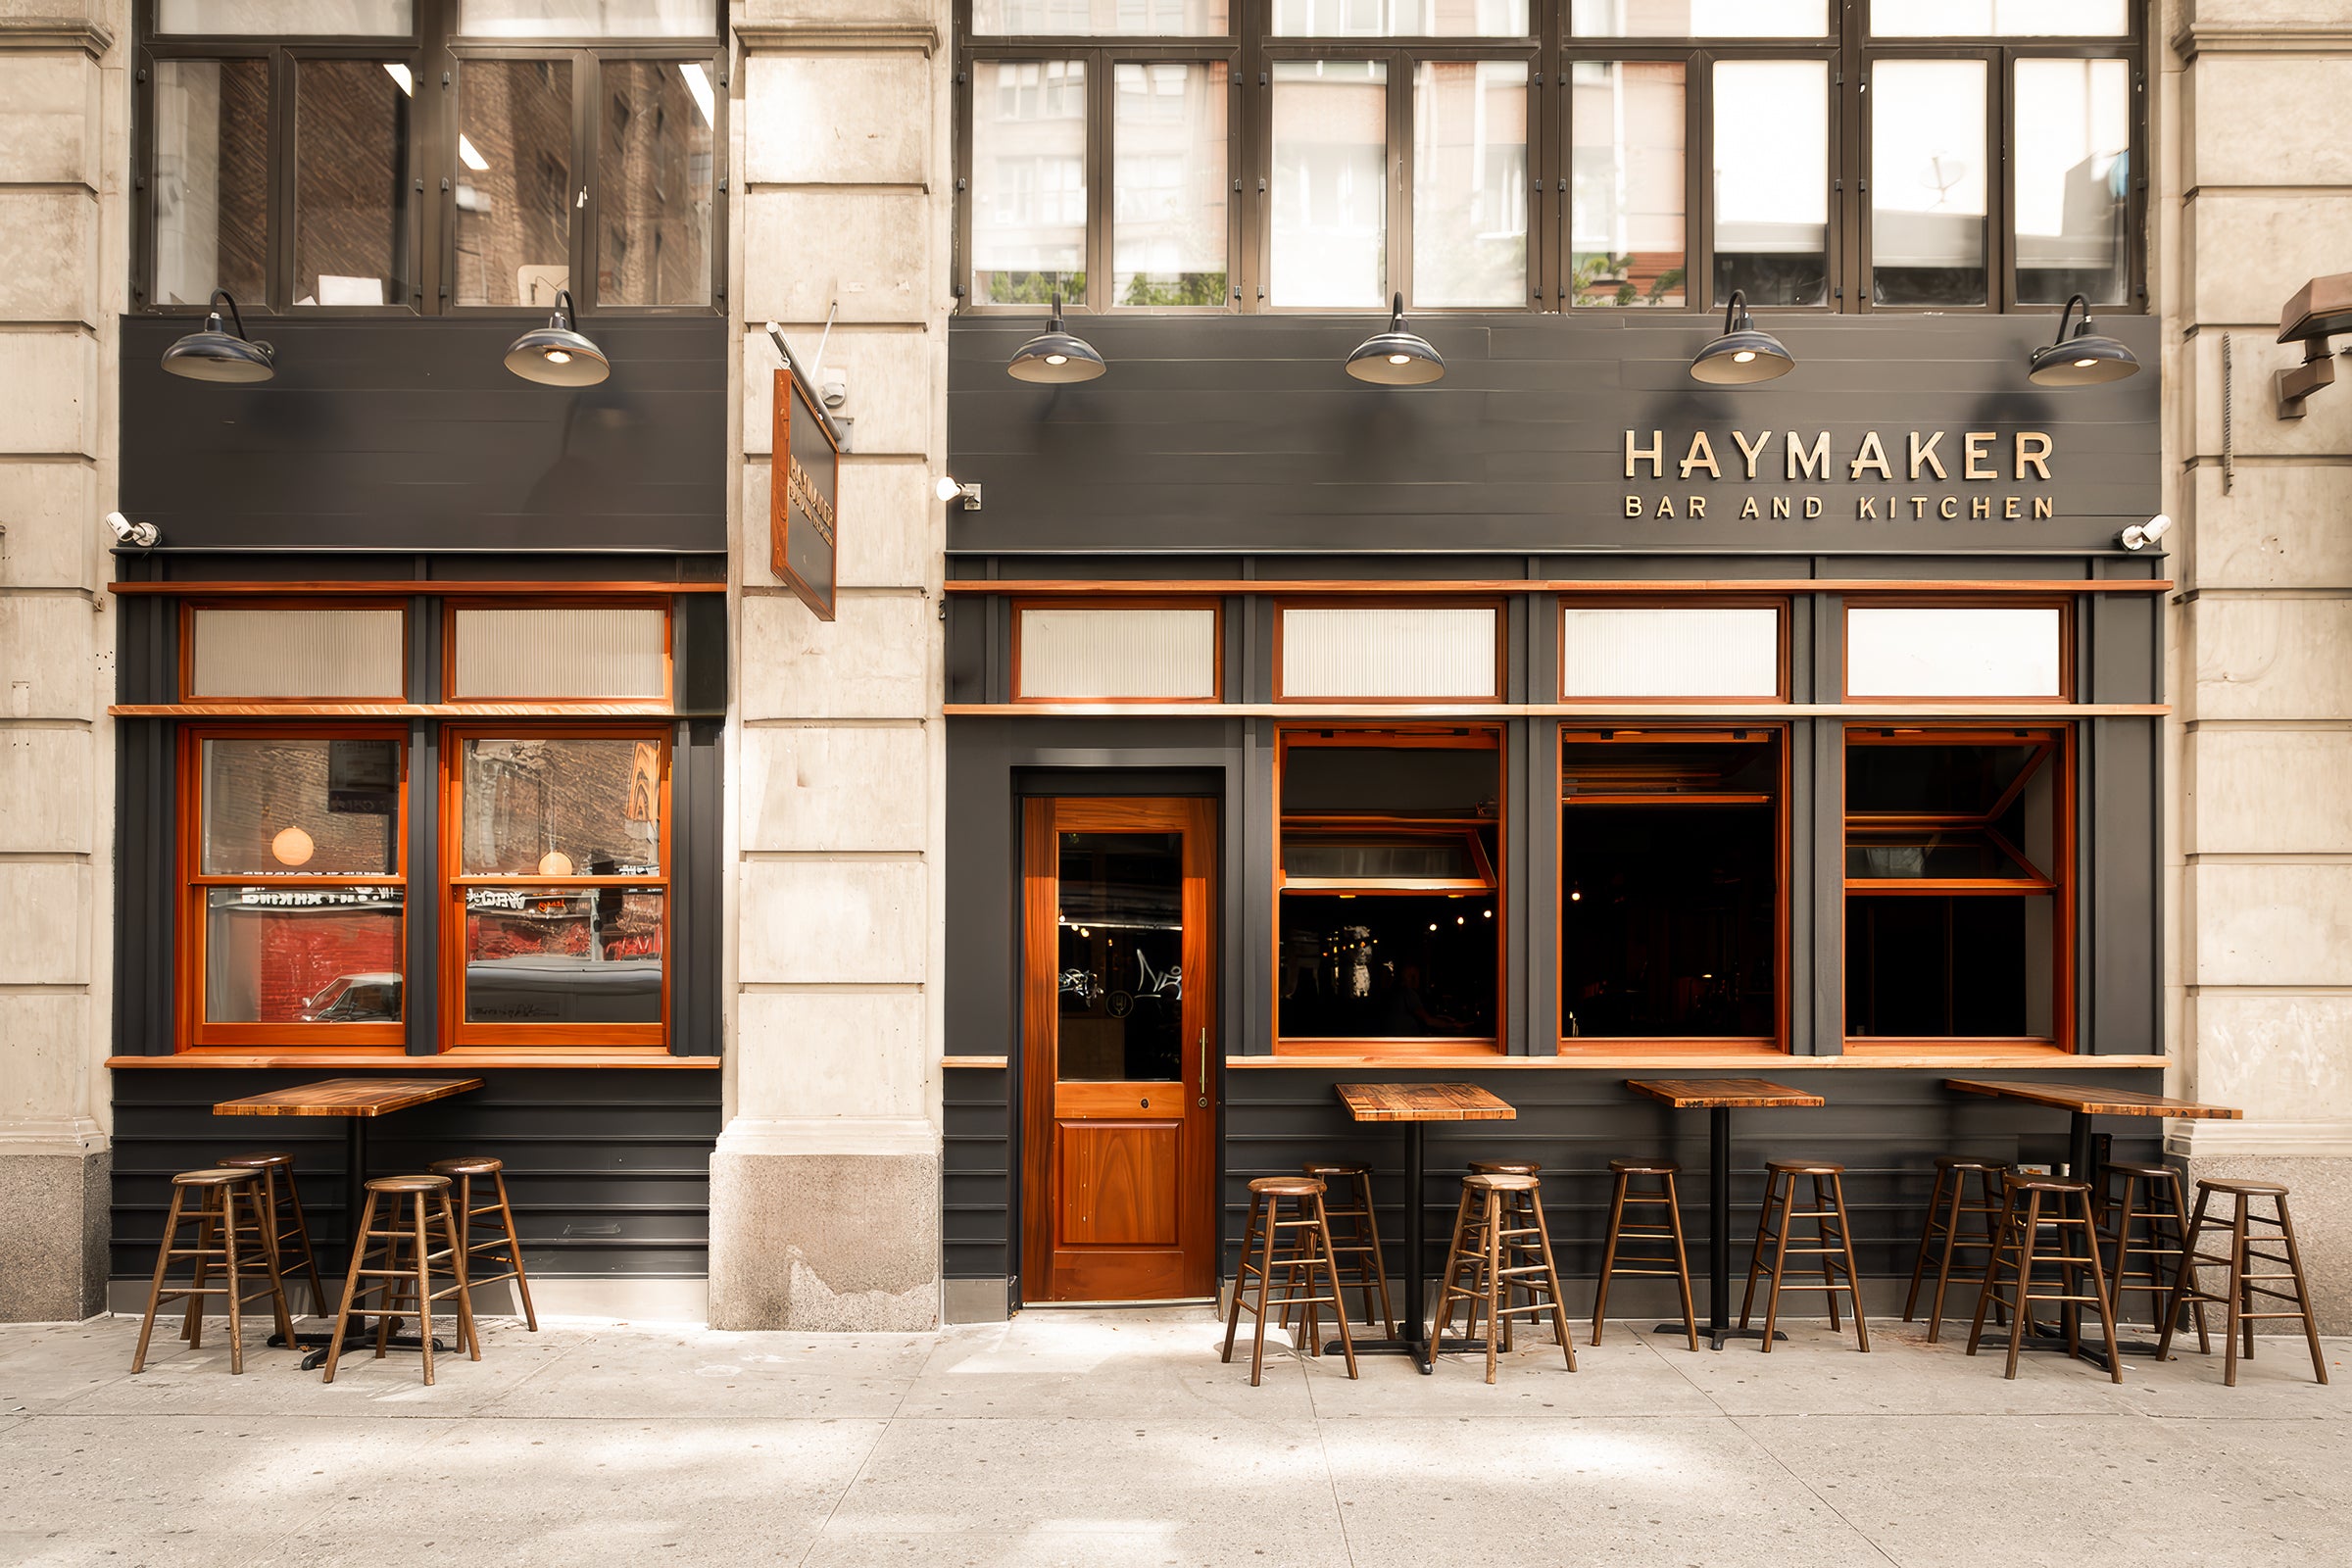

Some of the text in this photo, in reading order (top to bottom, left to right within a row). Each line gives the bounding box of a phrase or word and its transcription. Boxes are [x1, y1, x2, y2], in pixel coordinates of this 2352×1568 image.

[1624, 430, 2054, 479] HAYMAKER
[1624, 495, 2054, 519] BAR AND KITCHEN
